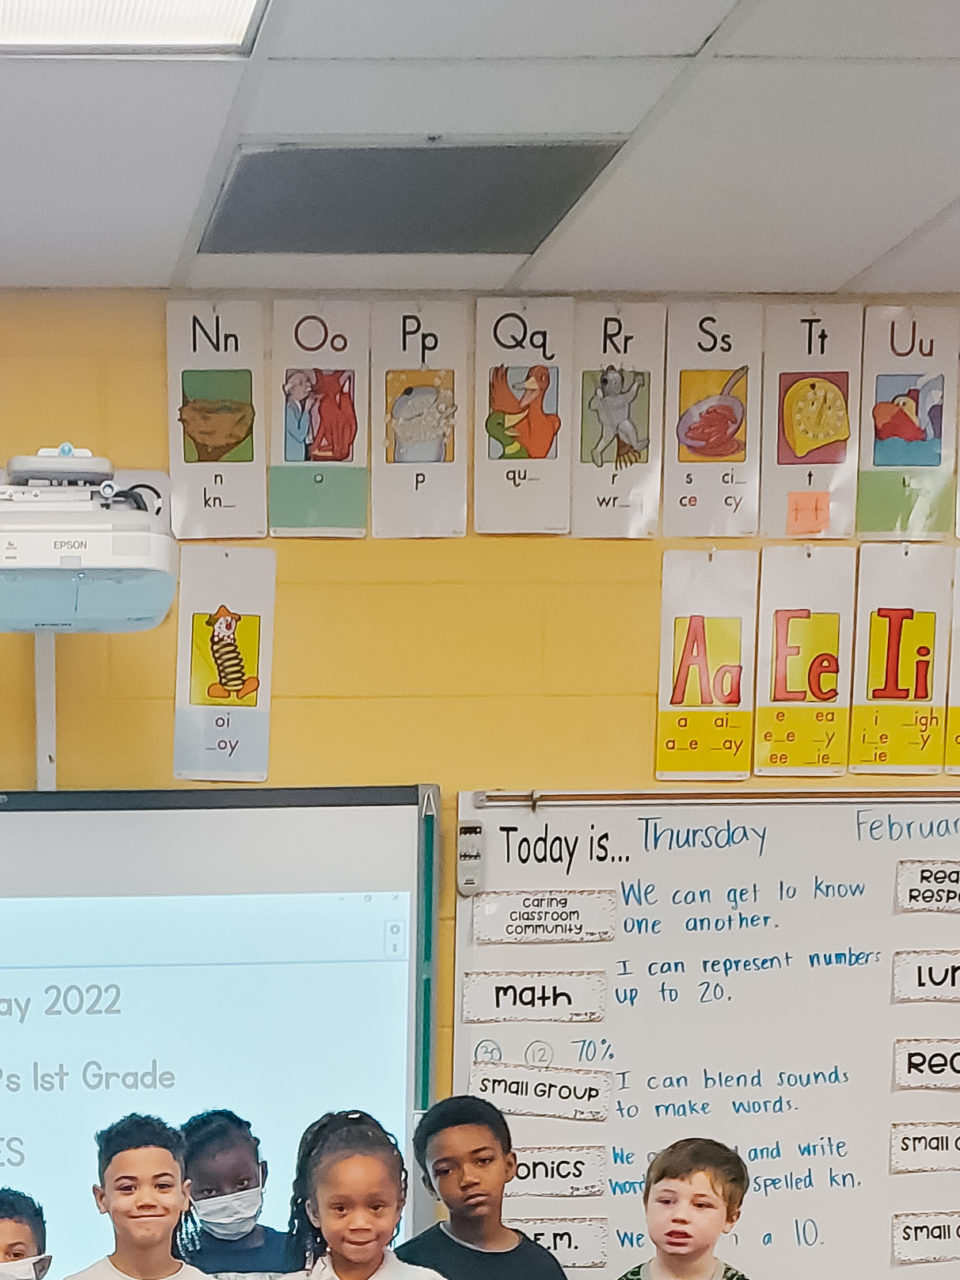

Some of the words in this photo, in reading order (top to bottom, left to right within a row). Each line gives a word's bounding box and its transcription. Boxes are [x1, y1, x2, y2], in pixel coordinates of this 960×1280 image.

[192, 315, 239, 353] Nn
[294, 315, 348, 353] Oo
[402, 314, 439, 364] Pp
[493, 312, 556, 361] Qq
[602, 317, 634, 355] Rr
[697, 316, 732, 353] Ss
[800, 318, 829, 355] Tt
[890, 320, 934, 357] Uu
[679, 495, 698, 508] ce
[724, 495, 743, 514] cy
[53, 540, 88, 551] EPSON
[668, 614, 744, 708] Aa
[773, 609, 839, 702] Ee
[872, 608, 930, 699] Ii
[215, 711, 230, 728] oi
[815, 711, 835, 723] ea
[769, 753, 788, 765] ee
[498, 823, 579, 876] Today
[637, 816, 767, 857] Thursday
[522, 897, 568, 909] caring
[620, 878, 658, 907] We
[671, 889, 711, 905] can
[726, 884, 761, 910] get
[505, 923, 583, 935] community
[509, 910, 580, 922] classroom
[623, 917, 662, 935] one
[685, 911, 779, 932] another.
[615, 959, 633, 976] I
[647, 961, 685, 976] can
[702, 951, 793, 977] represent
[808, 946, 881, 968] numbers
[44, 983, 122, 1016] 2022
[494, 984, 572, 1009] math
[614, 987, 639, 1007] up
[658, 981, 679, 1003] to
[697, 981, 732, 1003] 20.
[570, 1038, 615, 1062] 70%
[81, 1058, 176, 1091] Grade
[479, 1077, 529, 1096] small
[615, 1070, 631, 1091] I
[647, 1075, 688, 1090] can
[703, 1068, 762, 1089] blend
[777, 1065, 849, 1088] sounds
[615, 1100, 639, 1118] to
[654, 1099, 710, 1118] make
[731, 1095, 799, 1114] words.
[612, 1145, 636, 1165] We
[747, 1140, 781, 1162] and
[797, 1136, 848, 1158] write
[900, 1135, 949, 1153] small
[516, 1161, 585, 1180] onics
[753, 1167, 814, 1197] spelled
[829, 1167, 862, 1188] kn.
[608, 1175, 645, 1196] wor
[615, 1229, 645, 1248] We
[762, 1232, 773, 1246] a
[902, 1224, 951, 1242] small
